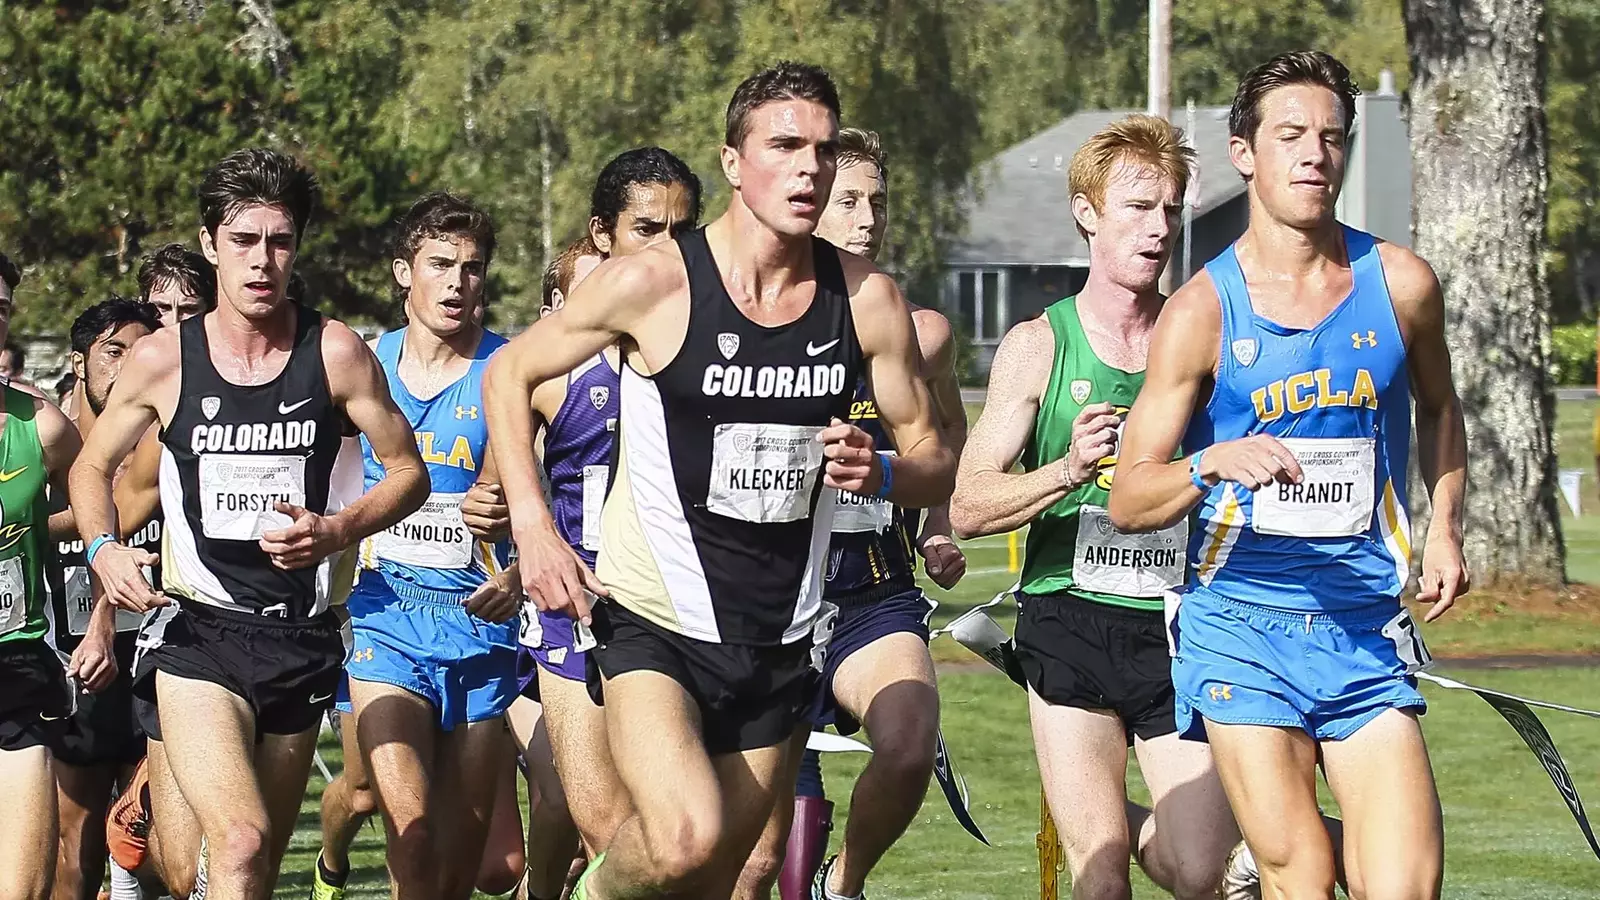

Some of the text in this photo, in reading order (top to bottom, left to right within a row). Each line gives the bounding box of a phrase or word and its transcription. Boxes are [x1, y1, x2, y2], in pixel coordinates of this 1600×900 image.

[701, 363, 846, 398] COLORADO
[1250, 368, 1378, 423] UCLA
[190, 419, 317, 452] COLORADO
[767, 437, 787, 445] CROSS
[788, 438, 811, 446] COUNTRY
[751, 445, 796, 453] CHAMPIONSHIPS
[729, 467, 806, 491] KLECKER
[1278, 482, 1355, 504] BRANDT
[1084, 545, 1177, 568] ANDERSON
